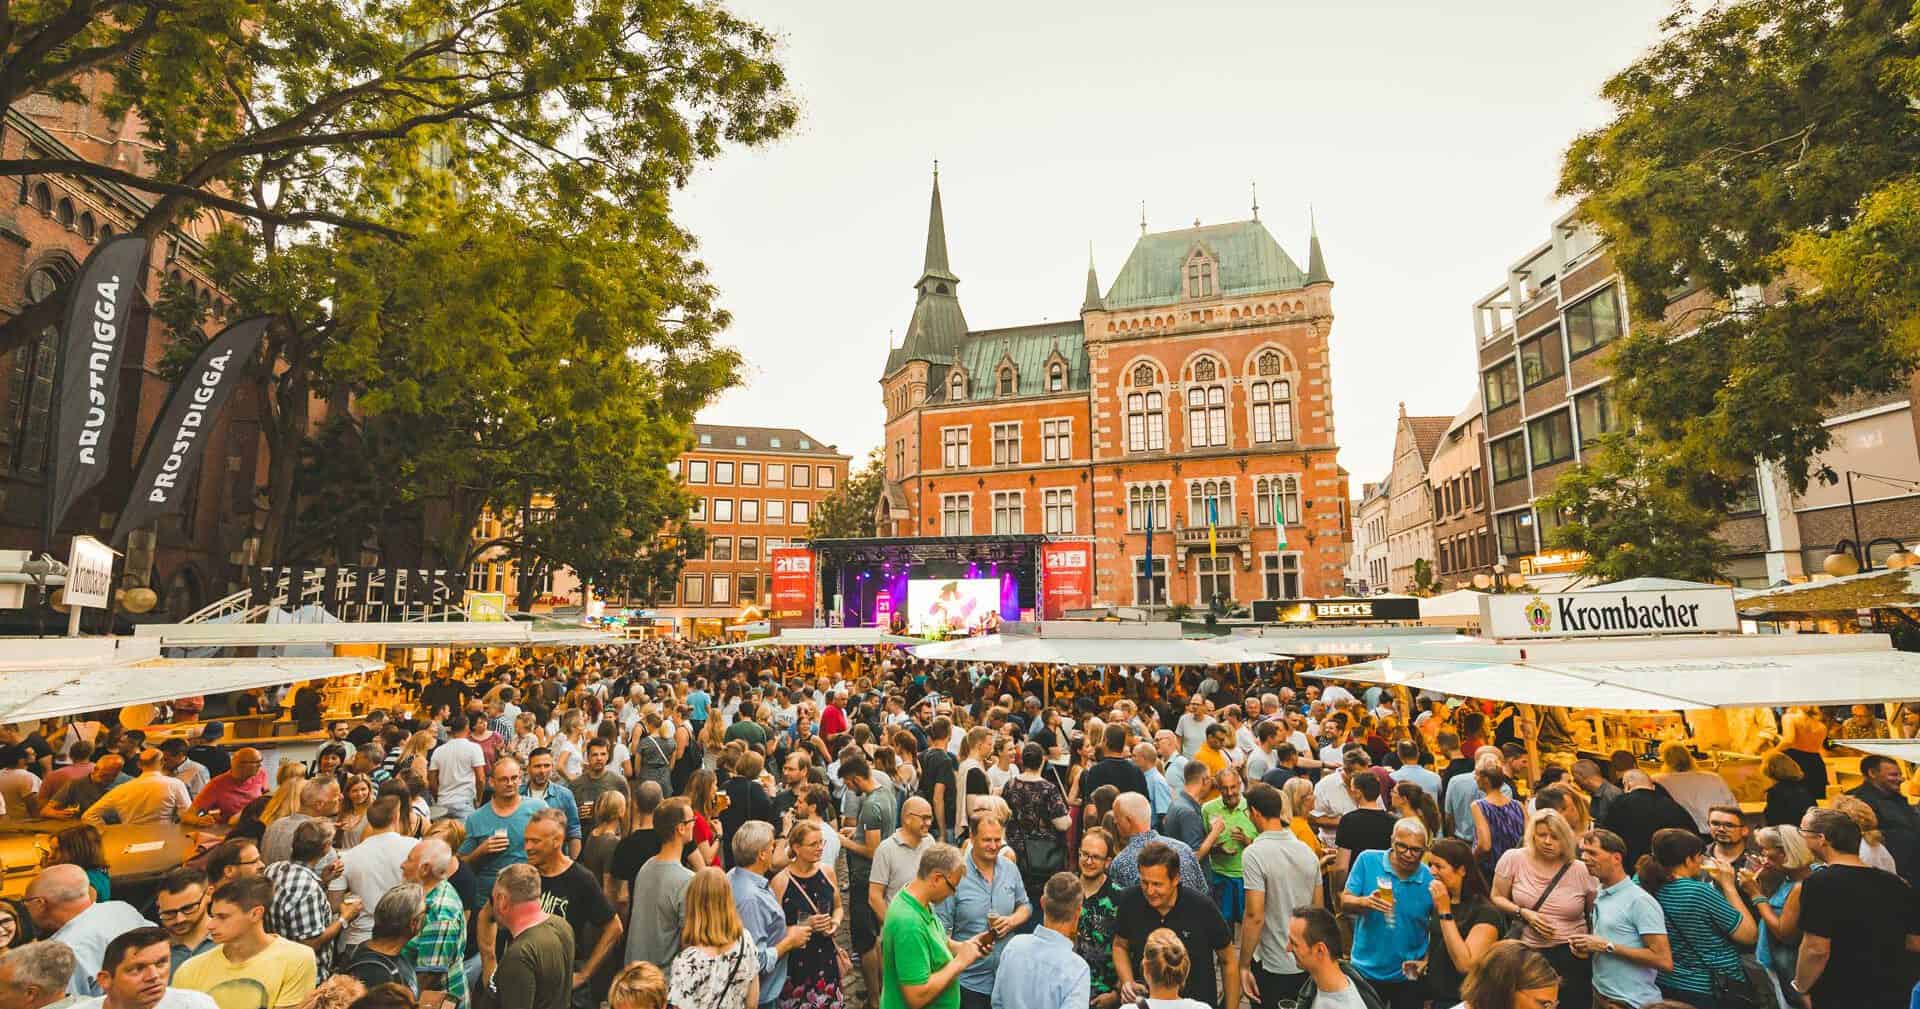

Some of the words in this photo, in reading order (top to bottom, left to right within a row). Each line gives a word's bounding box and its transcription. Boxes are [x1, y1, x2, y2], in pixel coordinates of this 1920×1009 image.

[149, 348, 234, 503] PROSTDIGGA.
[1317, 603, 1373, 615] BECK'S
[1557, 594, 1700, 631] Krombacher
